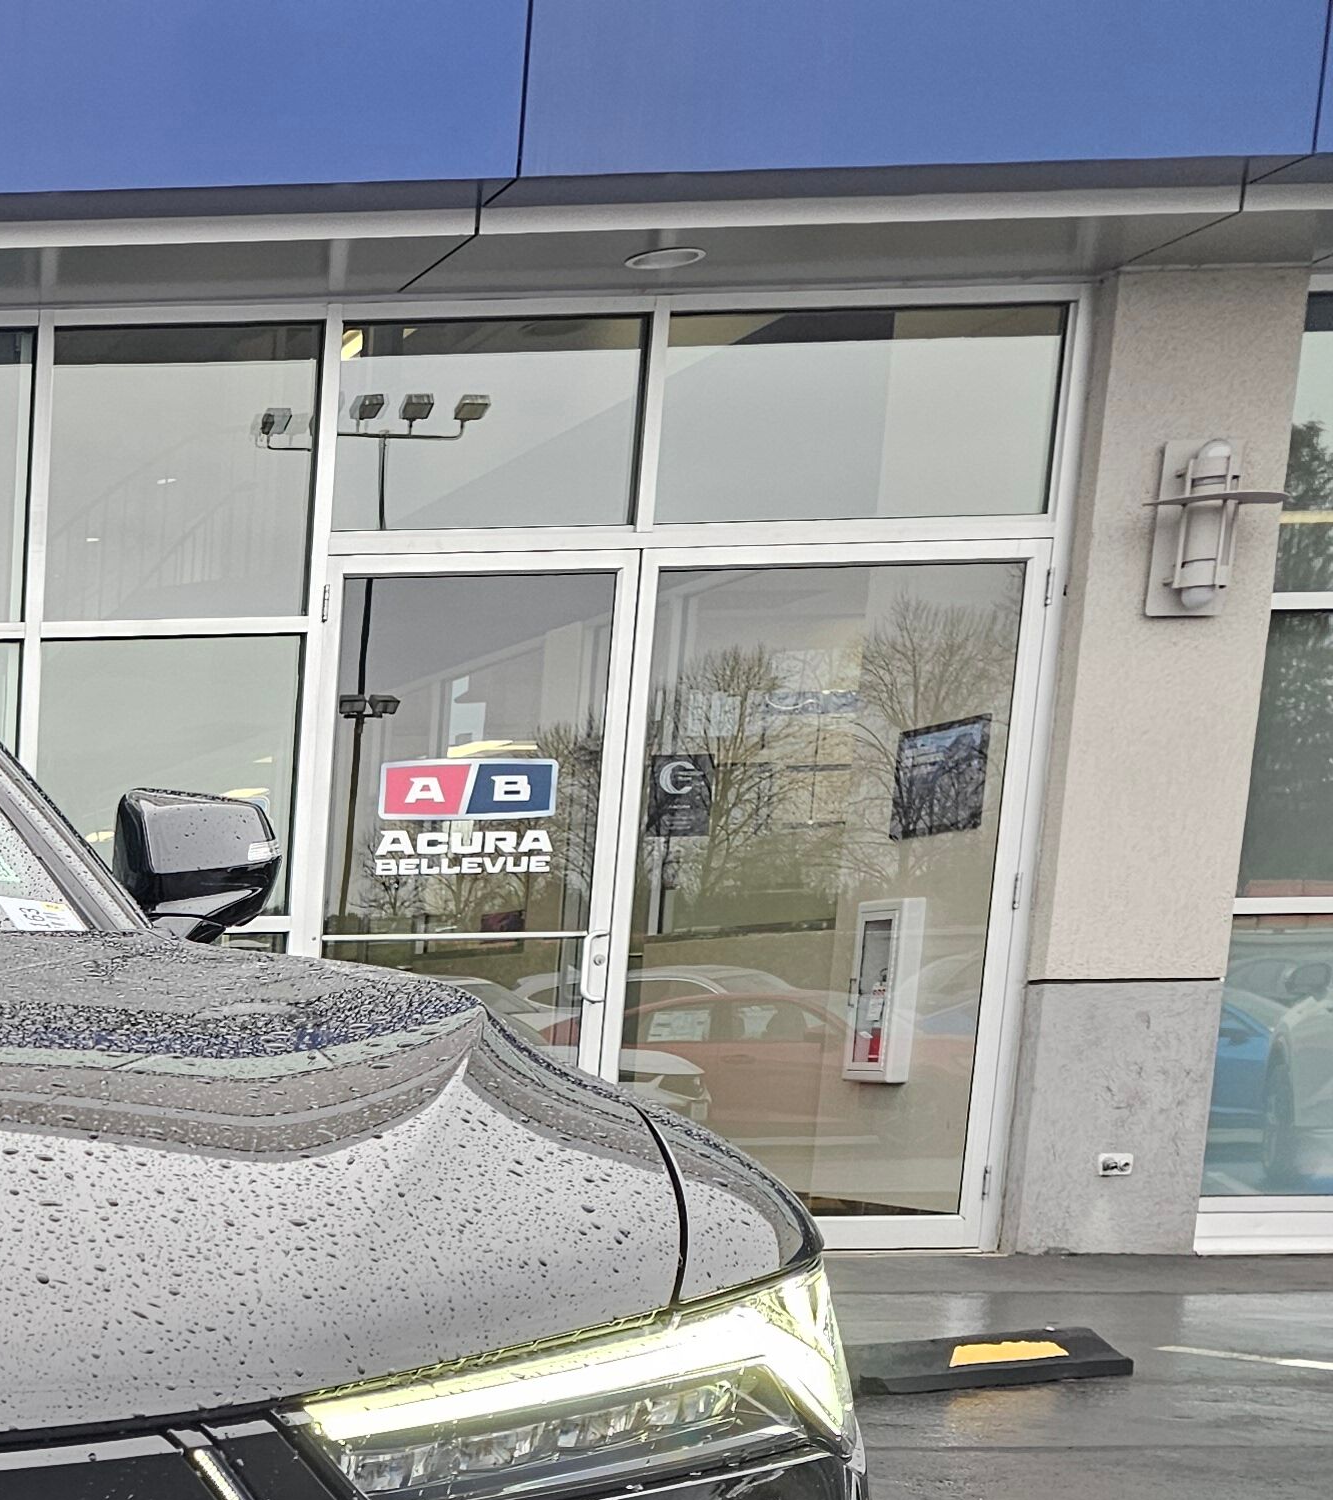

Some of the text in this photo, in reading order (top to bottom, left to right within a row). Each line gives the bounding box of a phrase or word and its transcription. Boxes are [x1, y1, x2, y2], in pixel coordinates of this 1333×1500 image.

[404, 775, 531, 803] A B
[374, 829, 554, 856] ACURA
[374, 855, 551, 876] BELLEVUE
